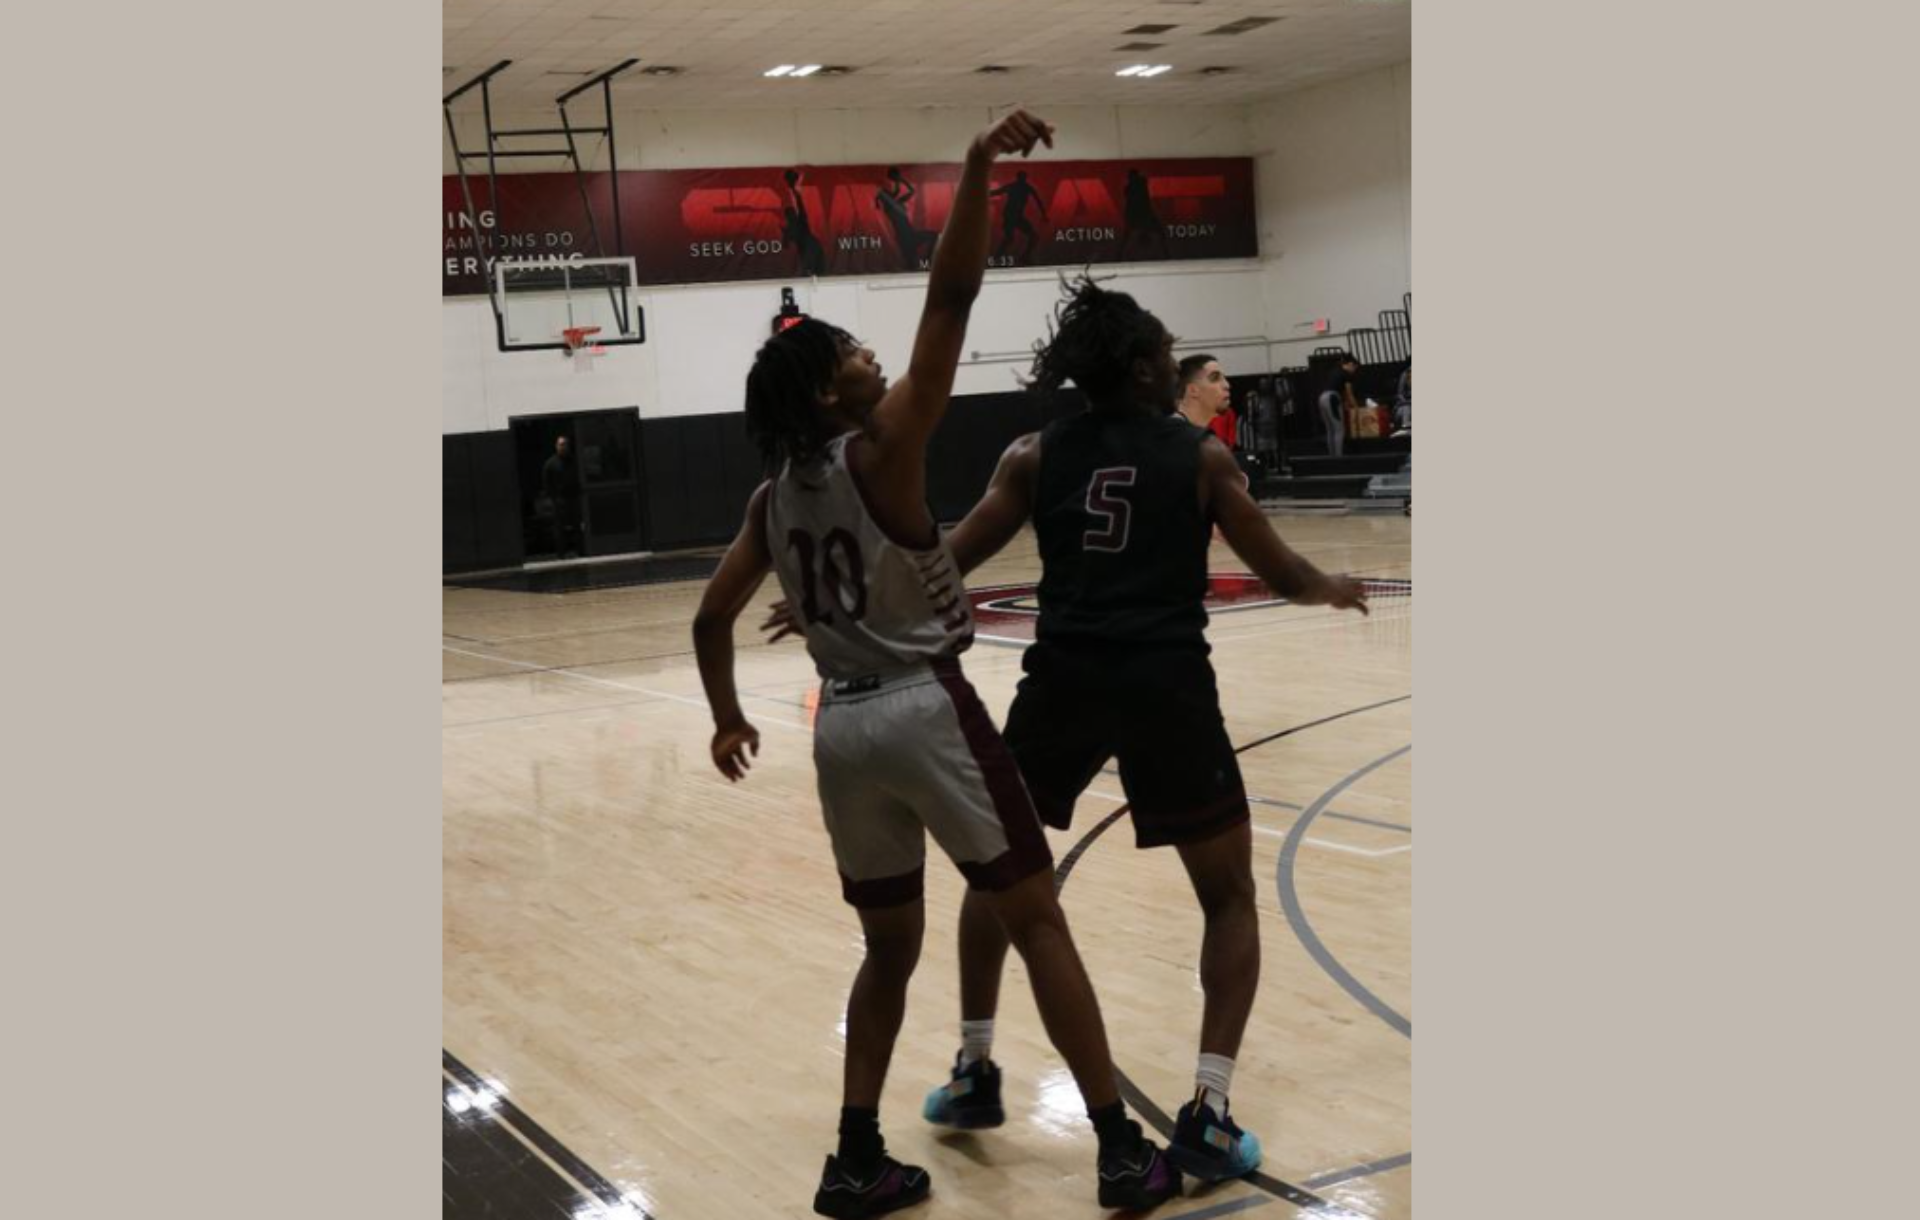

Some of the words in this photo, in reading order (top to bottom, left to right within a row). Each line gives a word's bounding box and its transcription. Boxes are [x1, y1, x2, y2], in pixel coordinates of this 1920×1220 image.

[447, 210, 496, 230] ING
[545, 231, 575, 247] DO
[690, 241, 735, 257] SEEK
[743, 240, 783, 255] GOD
[838, 236, 882, 250] WITH
[1055, 227, 1115, 242] ACTION
[1166, 224, 1217, 239] TODAY
[1083, 466, 1136, 553] 5
